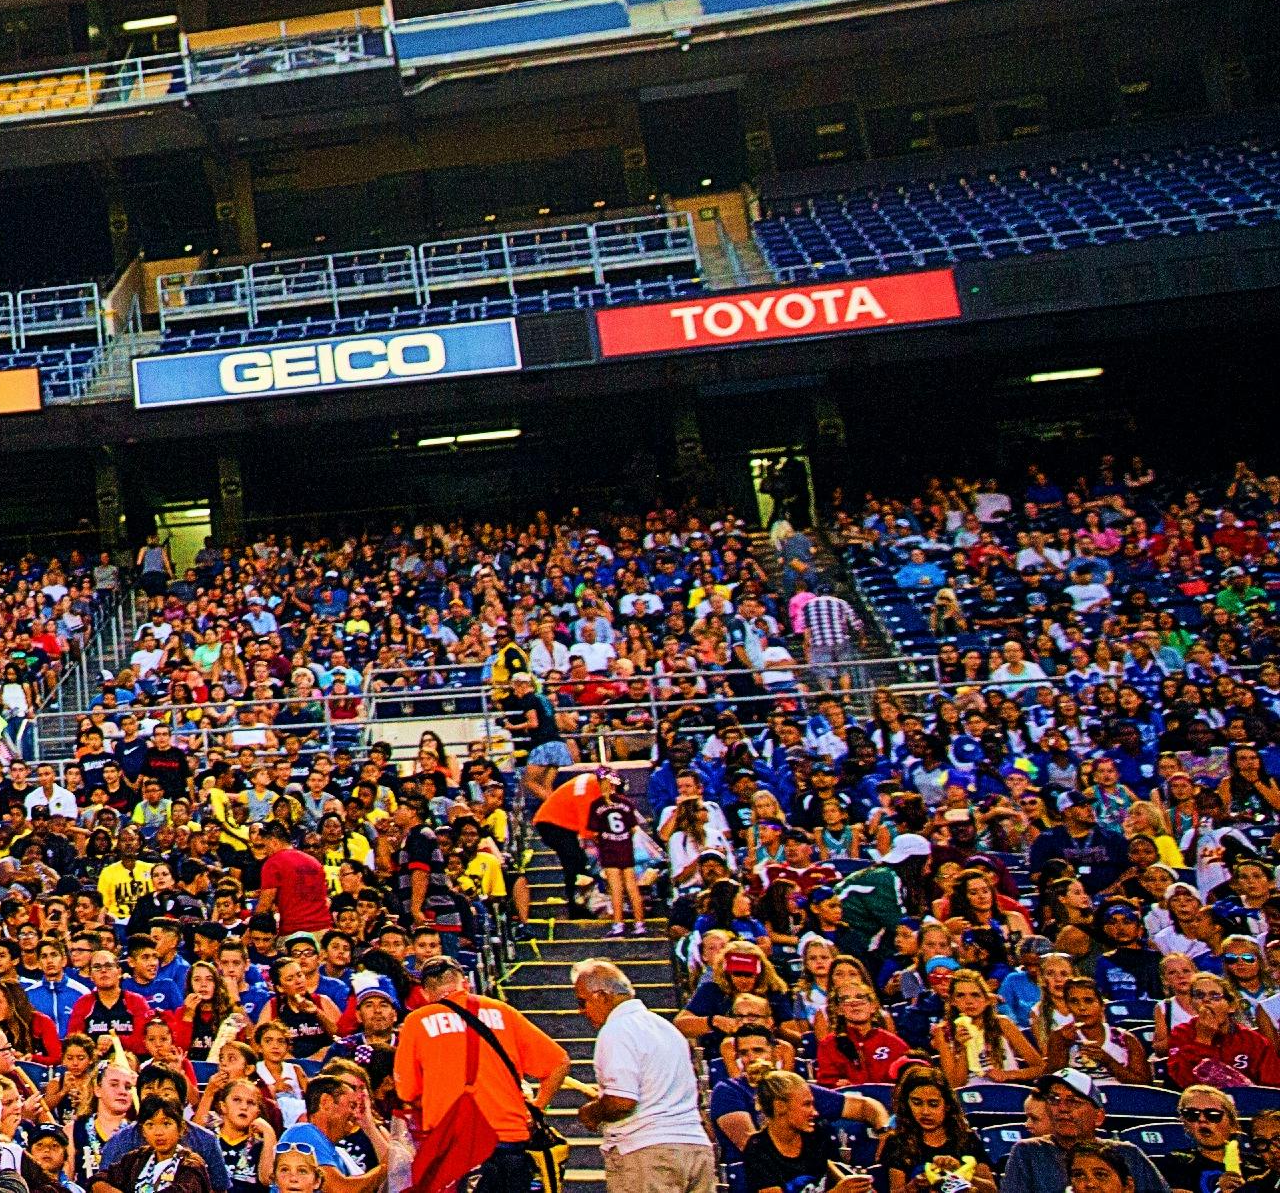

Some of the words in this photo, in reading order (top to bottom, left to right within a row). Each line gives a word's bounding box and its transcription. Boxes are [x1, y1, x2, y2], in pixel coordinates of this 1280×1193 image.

[672, 286, 885, 340] TOYOTA
[220, 333, 445, 394] GEICO
[608, 812, 626, 833] 6
[421, 1008, 505, 1038] VENOR
[873, 1046, 890, 1060] S
[1233, 1054, 1249, 1069] S
